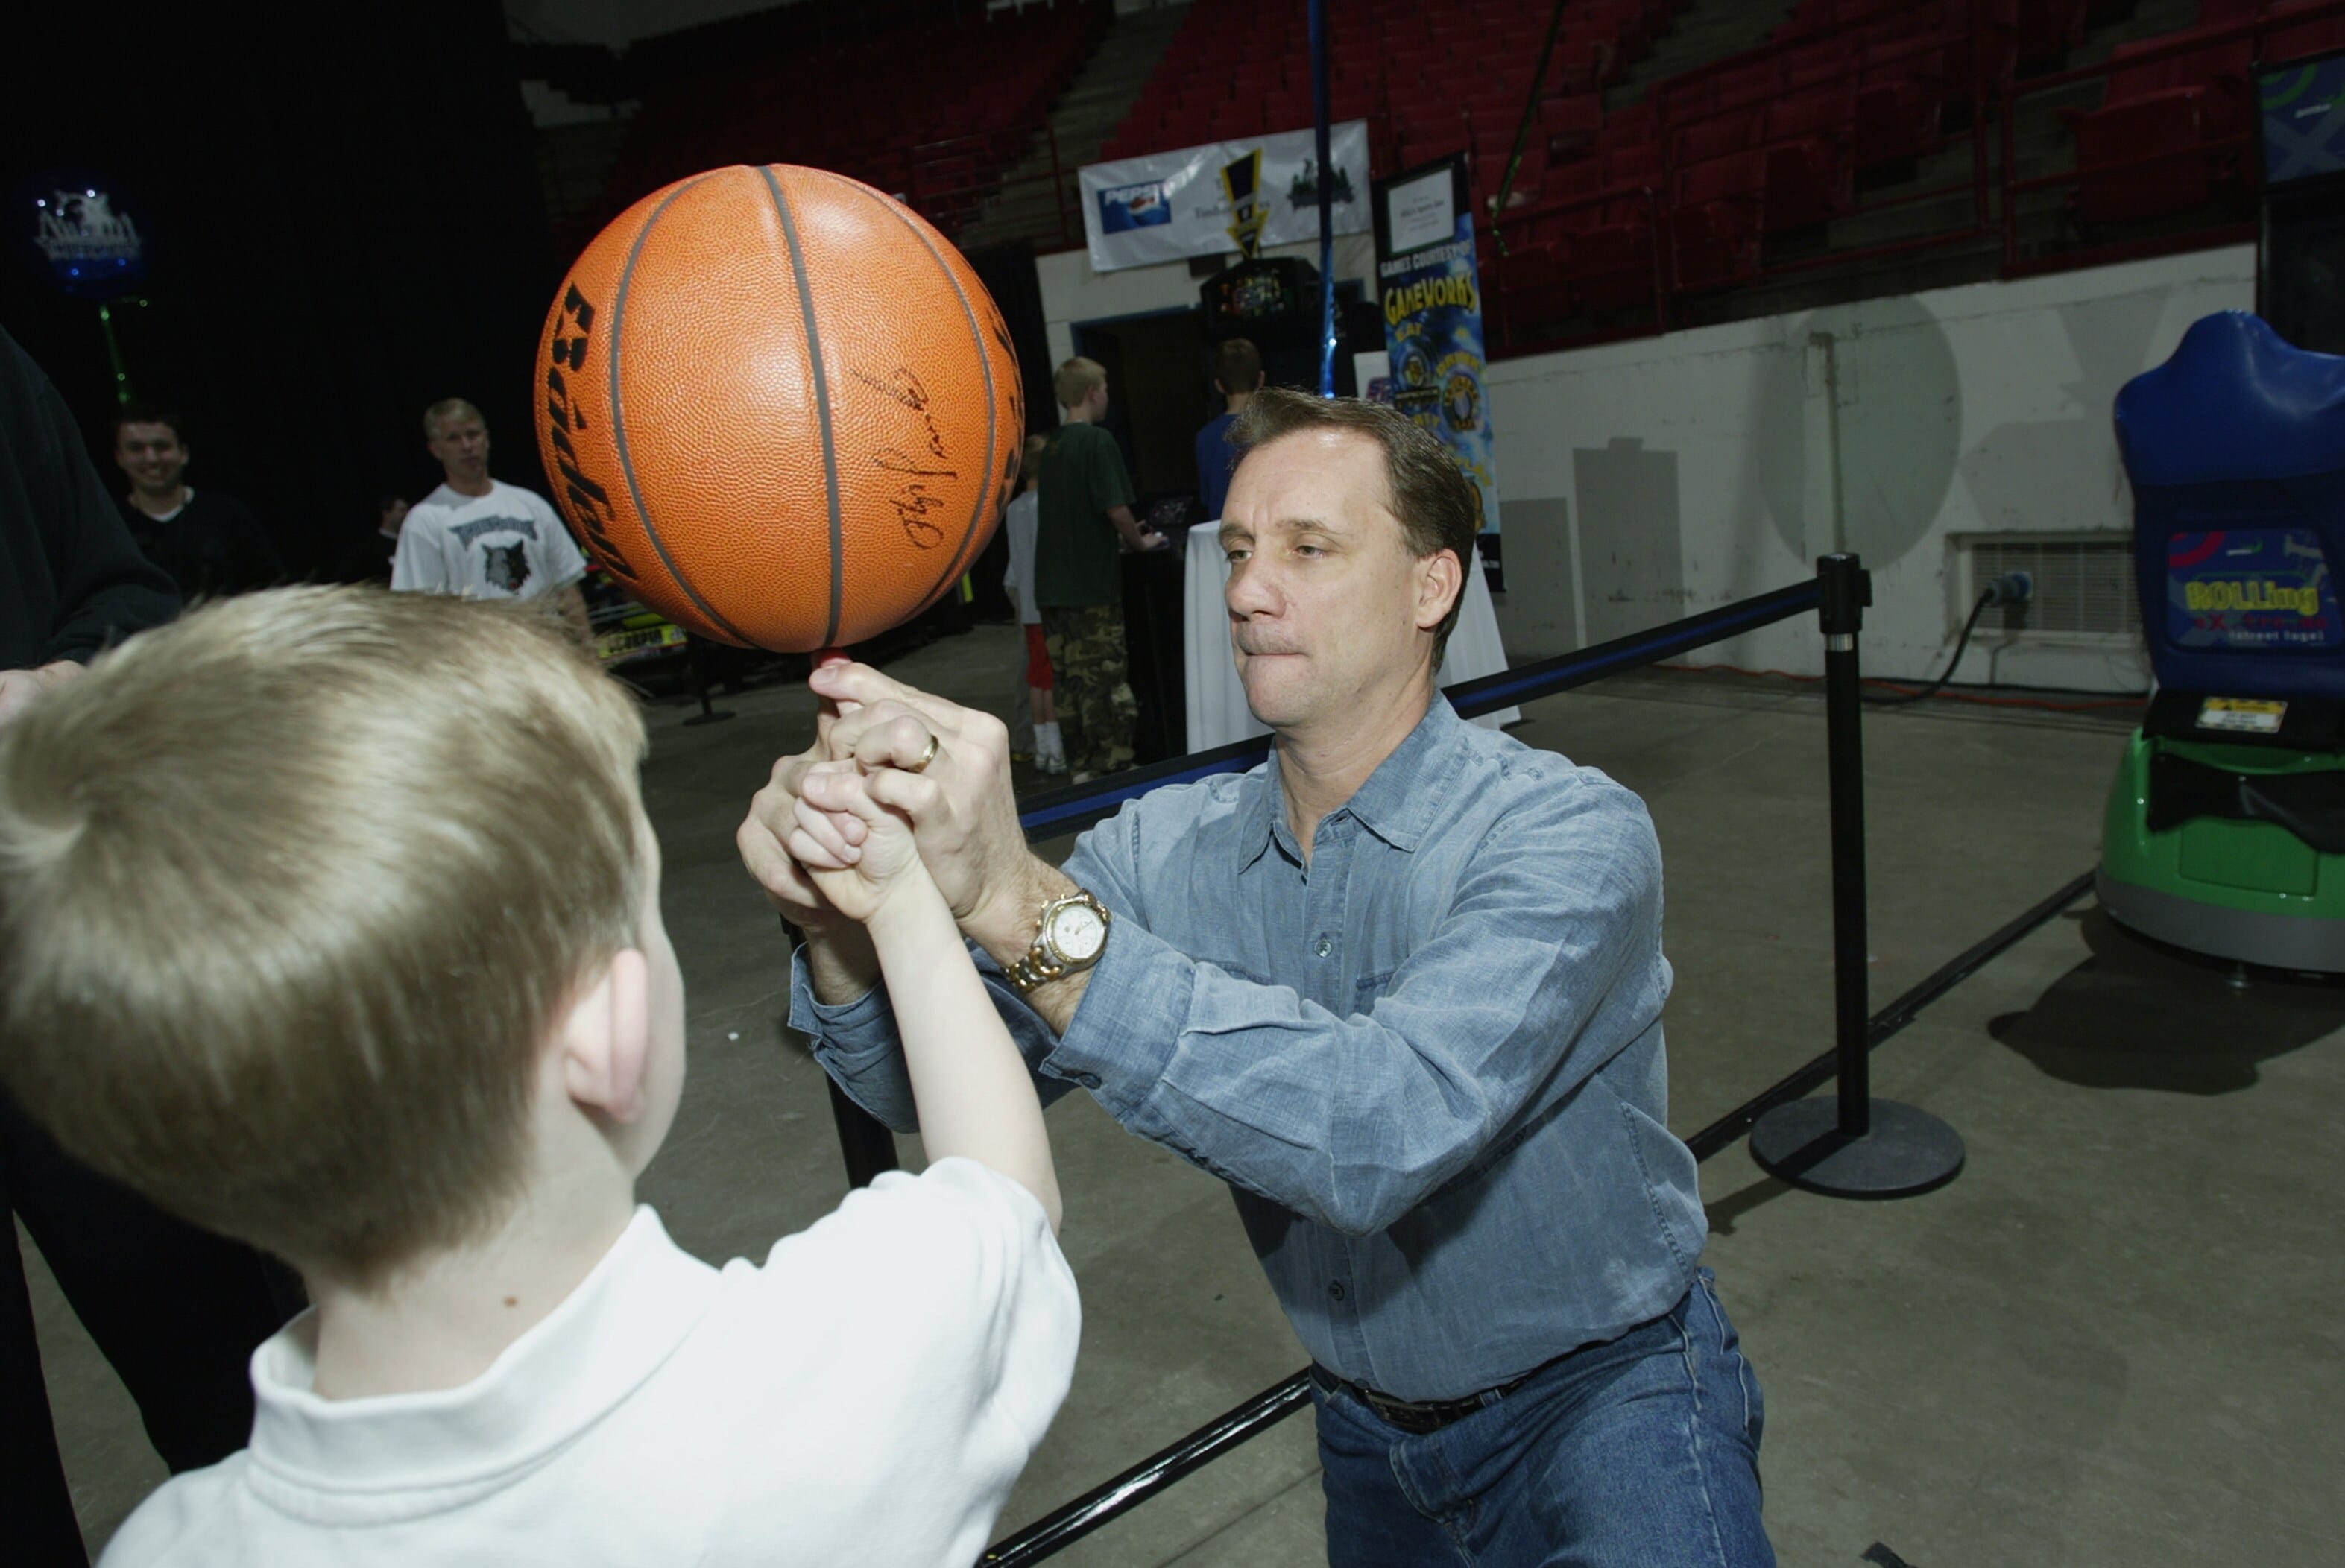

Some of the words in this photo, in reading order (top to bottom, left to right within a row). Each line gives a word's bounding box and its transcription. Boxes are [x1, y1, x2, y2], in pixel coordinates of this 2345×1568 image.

[1104, 182, 1159, 206] PEPSI
[1380, 256, 1411, 277] GAMES
[1413, 244, 1457, 270] COURTESY
